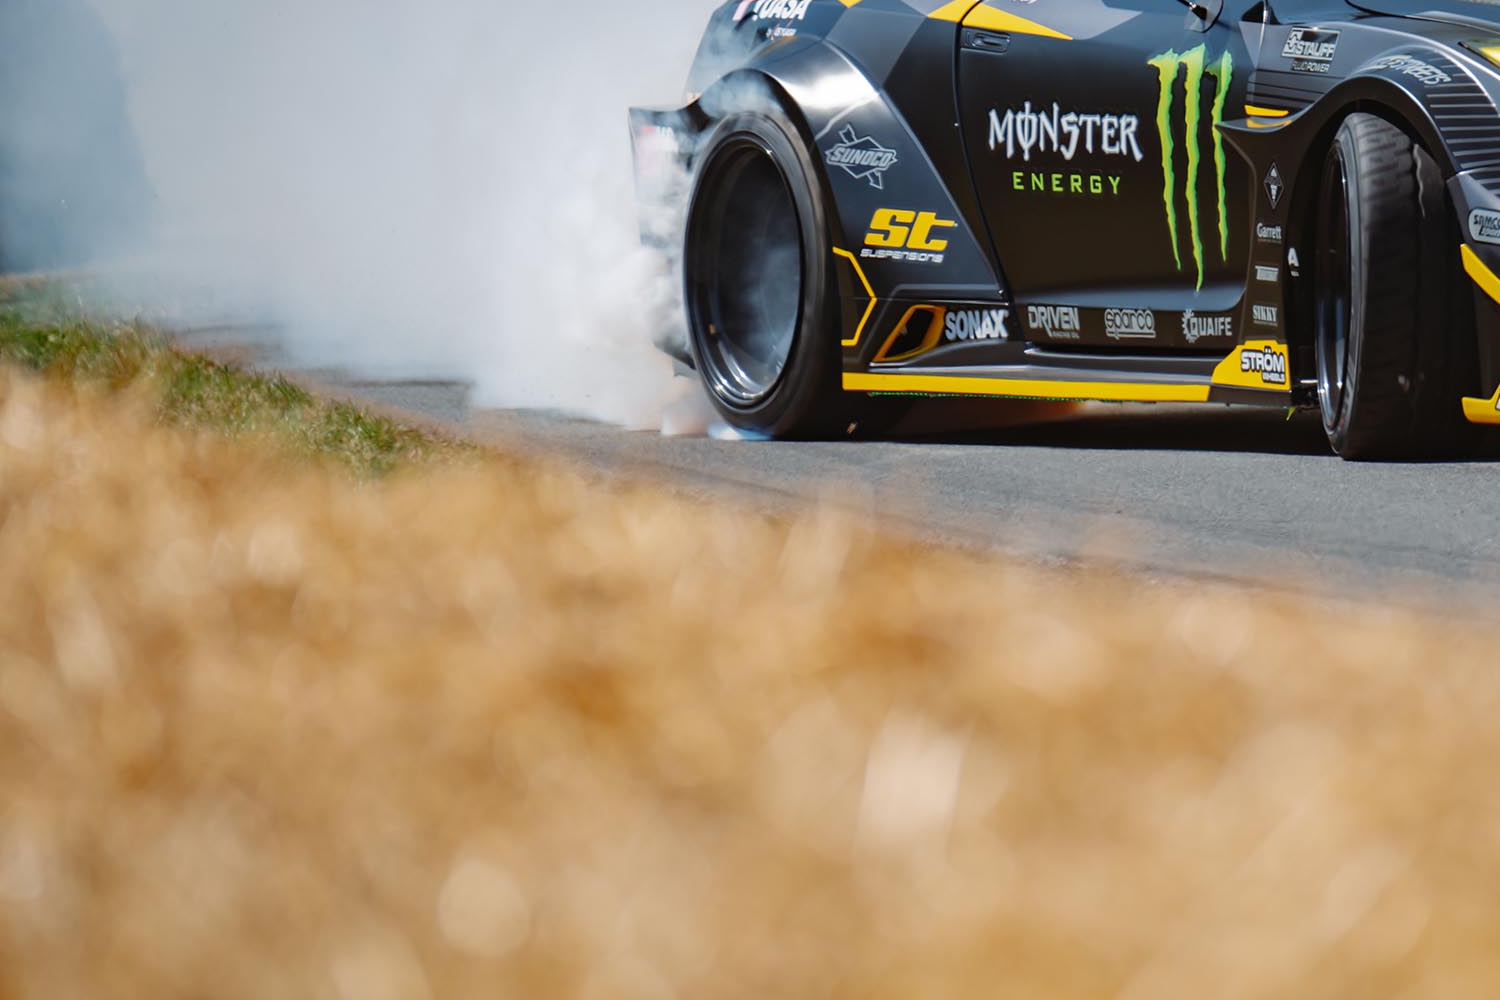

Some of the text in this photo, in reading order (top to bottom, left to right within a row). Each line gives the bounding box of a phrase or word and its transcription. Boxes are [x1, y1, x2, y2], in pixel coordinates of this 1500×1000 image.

[1296, 42, 1335, 58] STAUFF
[831, 149, 890, 167] SUNOCO
[1012, 171, 1121, 194] ENERGY
[945, 309, 1008, 340] SONAX
[1028, 306, 1080, 334] DRIVEN
[1104, 308, 1156, 340] sparco
[1187, 314, 1233, 338] QUAIFE
[1241, 347, 1285, 372] STRÖM
